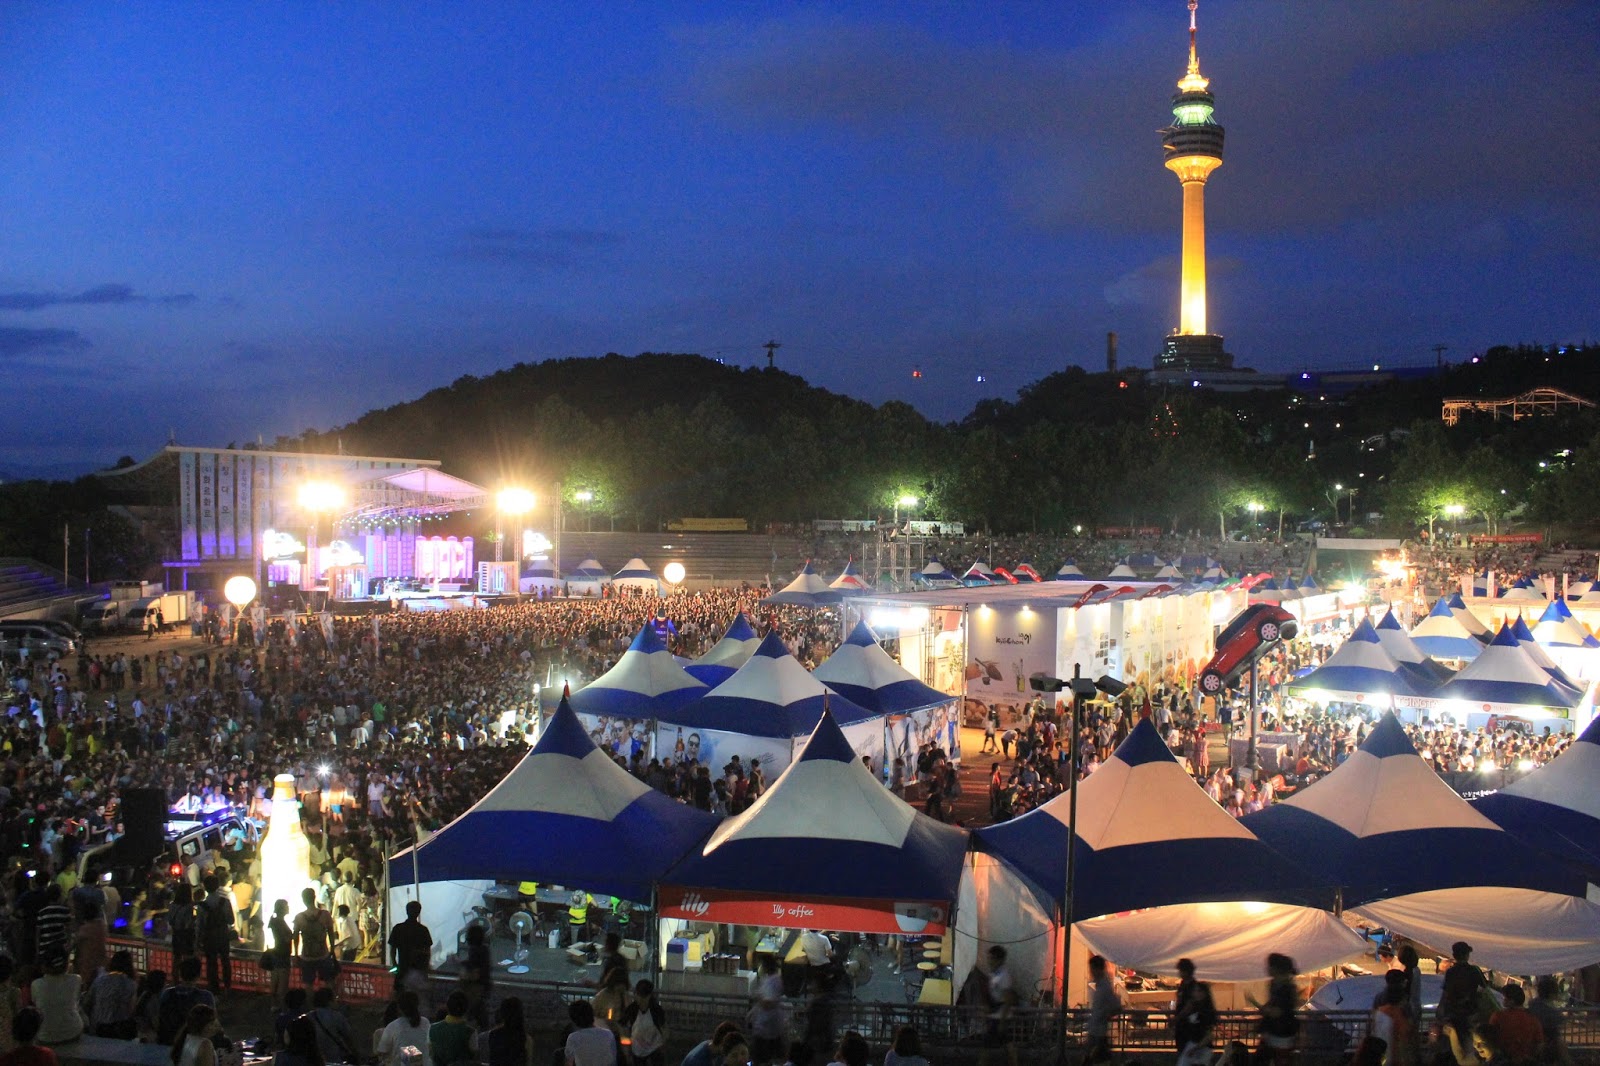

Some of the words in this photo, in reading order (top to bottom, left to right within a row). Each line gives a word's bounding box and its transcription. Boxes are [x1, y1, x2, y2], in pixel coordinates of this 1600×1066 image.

[680, 892, 709, 917] illy
[772, 904, 785, 919] Illy
[788, 905, 814, 918] coffee
